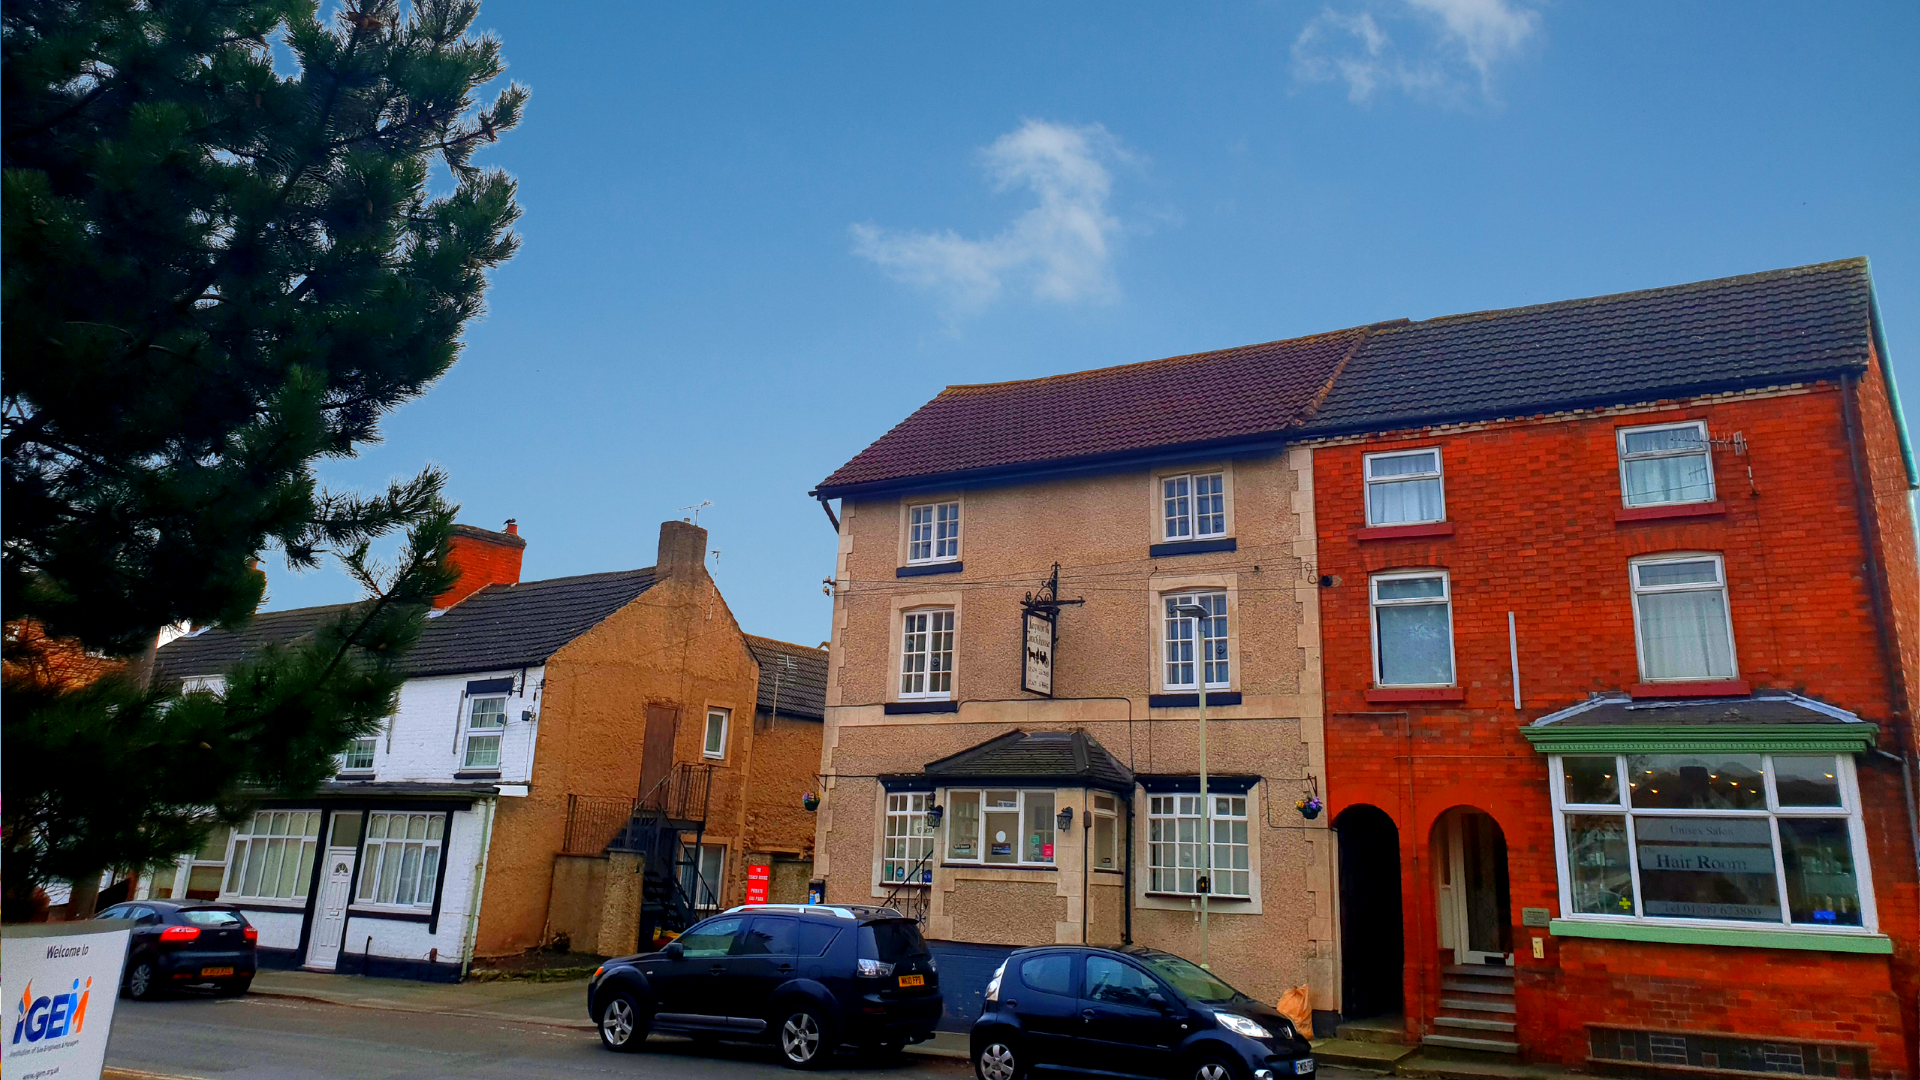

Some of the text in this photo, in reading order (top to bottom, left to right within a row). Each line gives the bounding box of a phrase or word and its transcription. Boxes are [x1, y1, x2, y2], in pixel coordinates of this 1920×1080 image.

[1670, 825, 1734, 837] Unisex Salon
[1656, 854, 1747, 871] Hair Room
[46, 944, 89, 959] Welcome to
